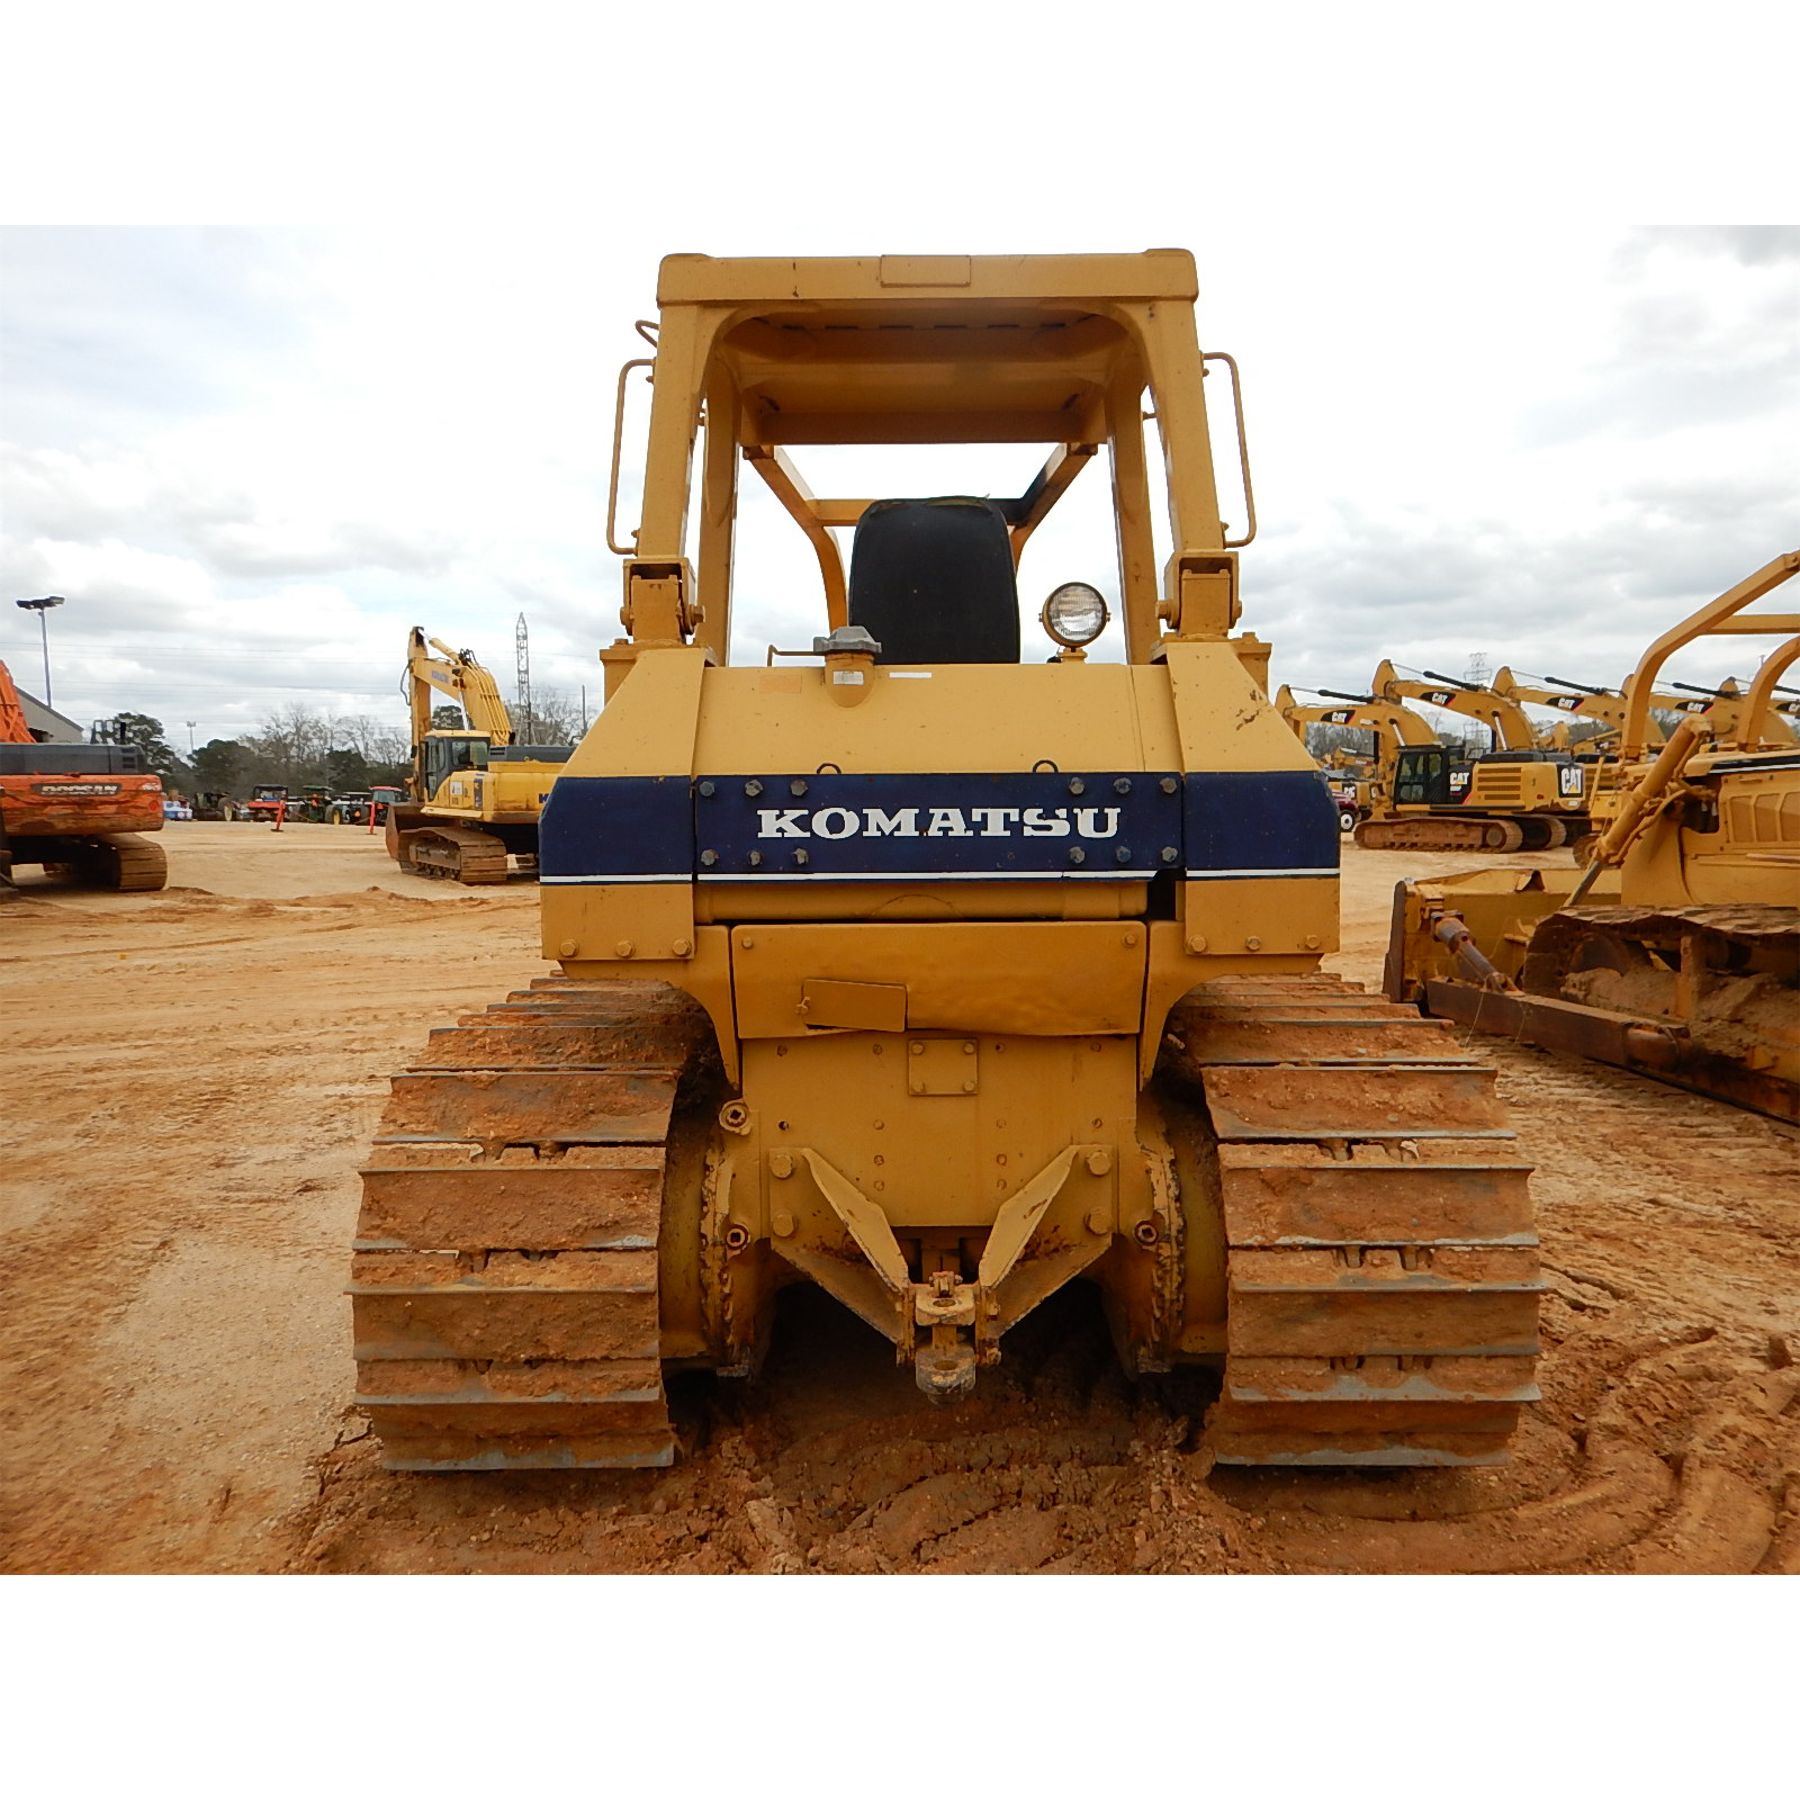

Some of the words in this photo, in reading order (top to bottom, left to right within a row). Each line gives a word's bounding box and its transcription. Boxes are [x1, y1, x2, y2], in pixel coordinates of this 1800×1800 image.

[1450, 772, 1469, 785] CAT
[1561, 768, 1581, 794] CAT
[756, 807, 1121, 839] KOMATSU
